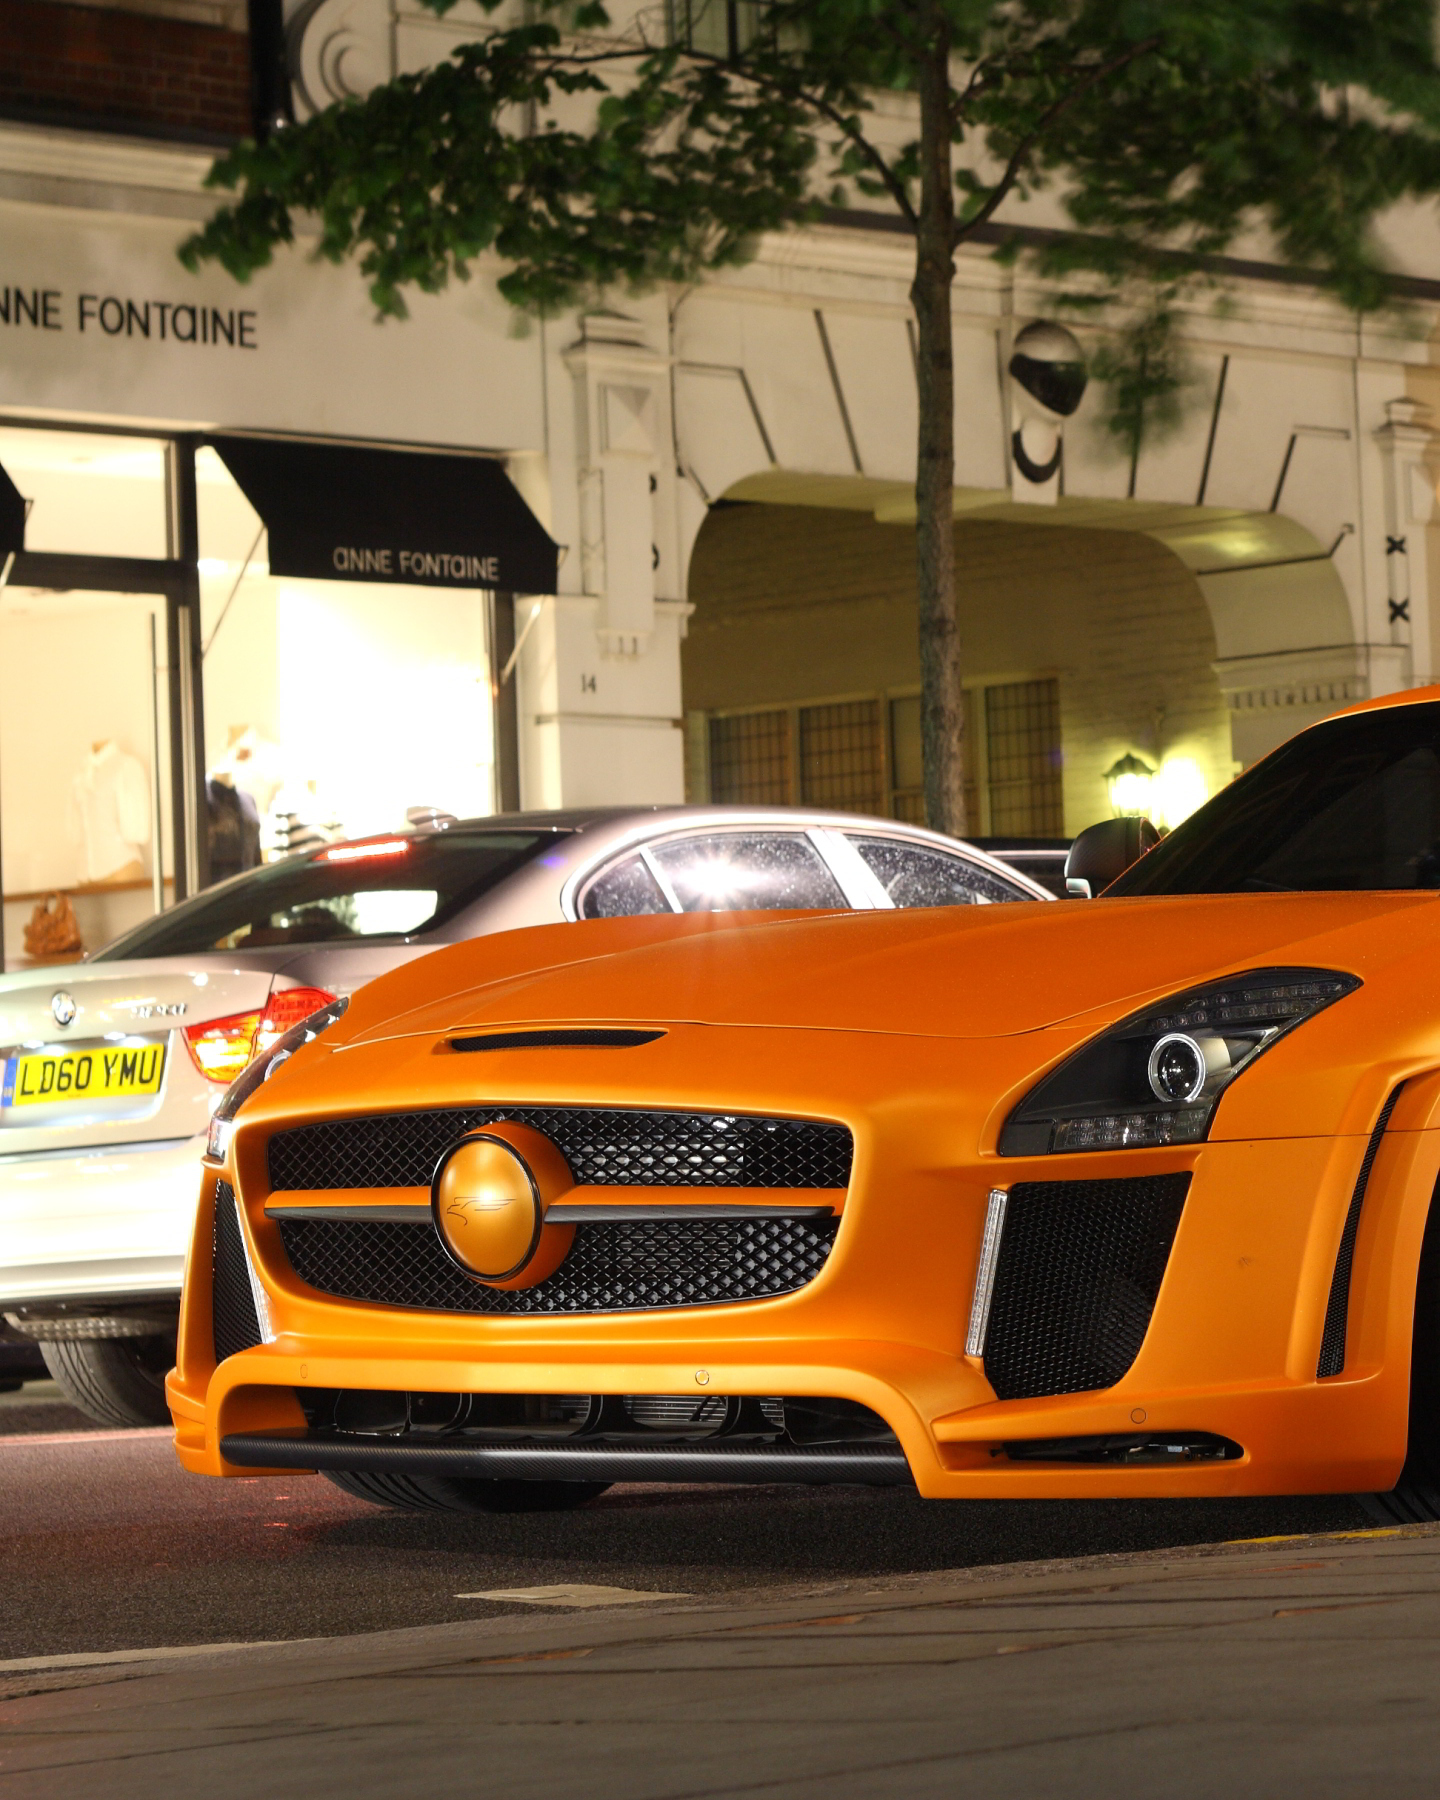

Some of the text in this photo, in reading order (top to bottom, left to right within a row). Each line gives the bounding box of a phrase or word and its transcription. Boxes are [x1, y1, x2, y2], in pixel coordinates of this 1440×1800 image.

[580, 673, 597, 693] 14
[20, 1049, 158, 1097] LD60 YMU
